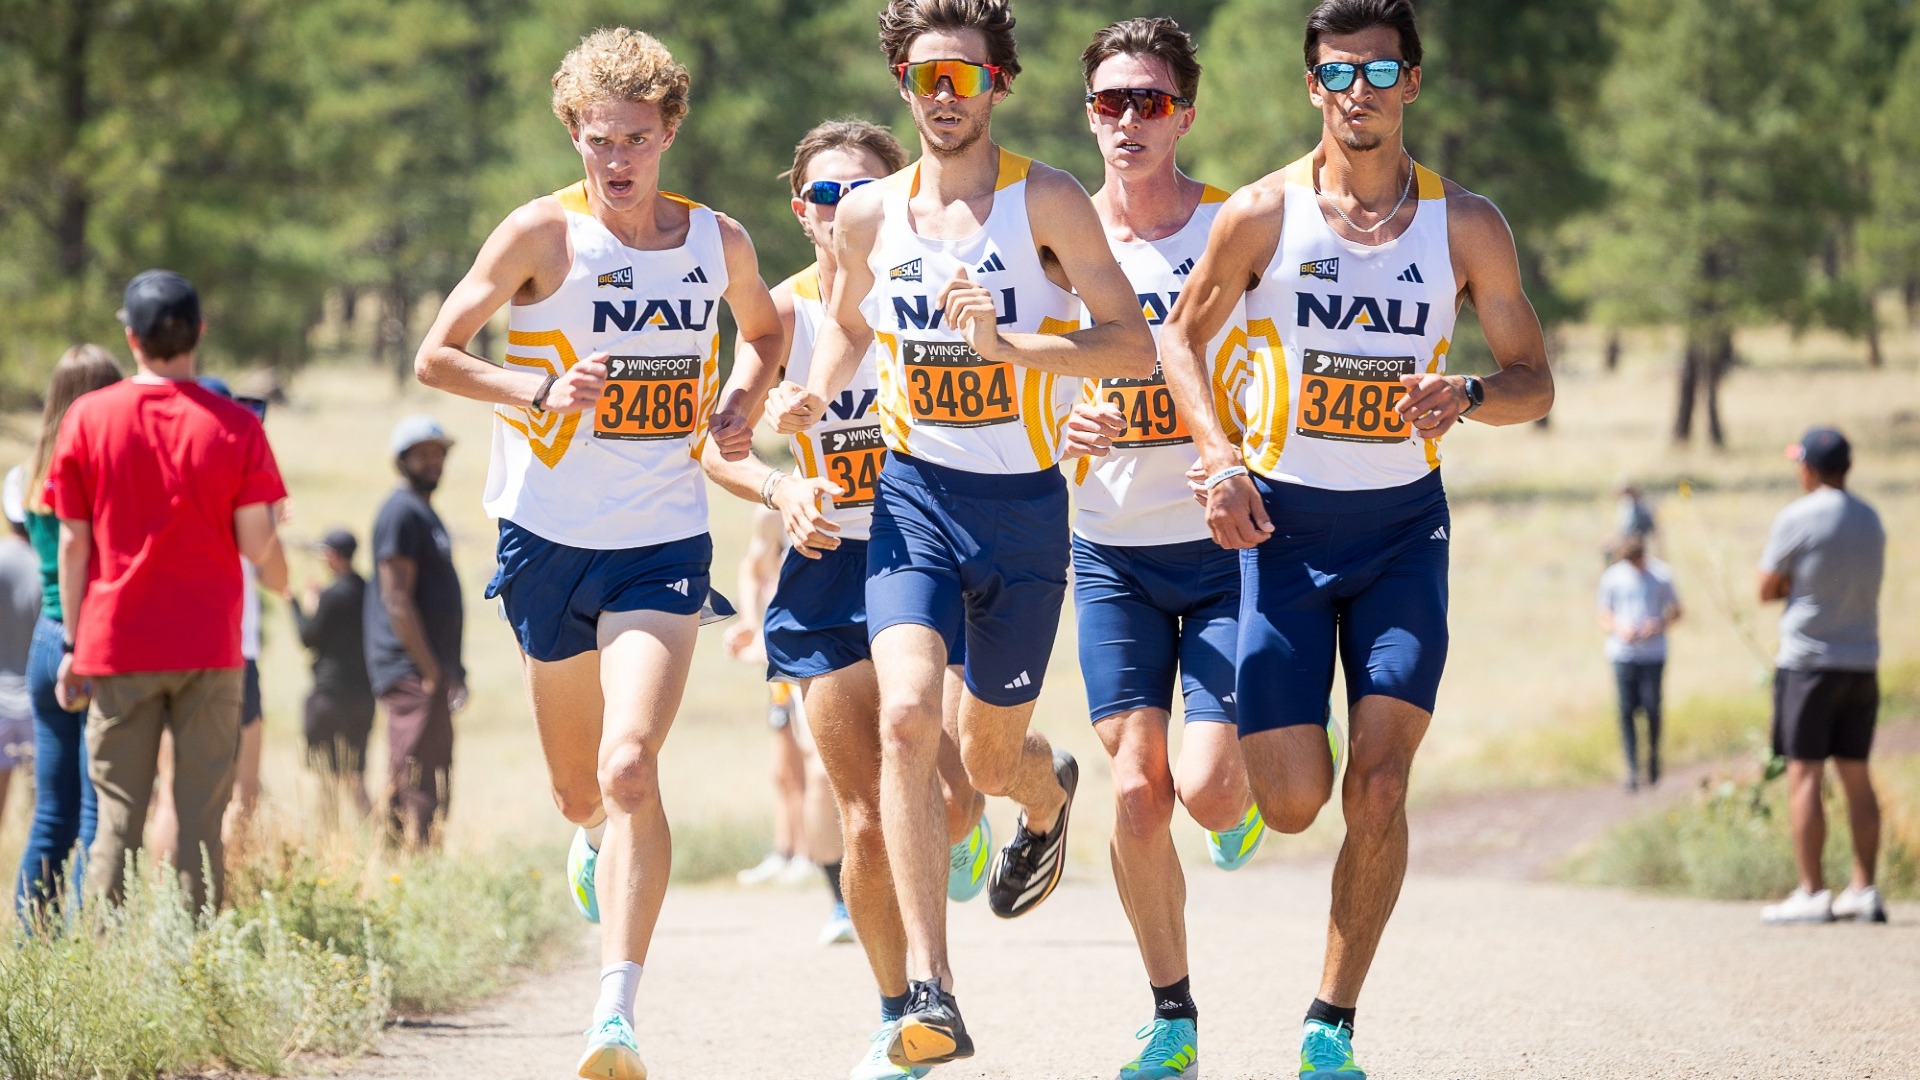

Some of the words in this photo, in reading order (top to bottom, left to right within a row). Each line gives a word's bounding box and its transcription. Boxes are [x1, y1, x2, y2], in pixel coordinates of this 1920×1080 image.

[592, 299, 714, 333] NAU
[892, 287, 1017, 330] NU
[1295, 291, 1430, 336] NAU
[627, 358, 692, 371] WINGFOOT
[927, 344, 979, 356] WINGFO
[1333, 356, 1405, 371] WINGFOOT
[601, 382, 693, 430] 3486
[911, 367, 1012, 417] 3484
[1107, 387, 1177, 438] 349
[1303, 379, 1407, 433] 3485
[847, 428, 880, 441] WING
[831, 452, 887, 498] 34
